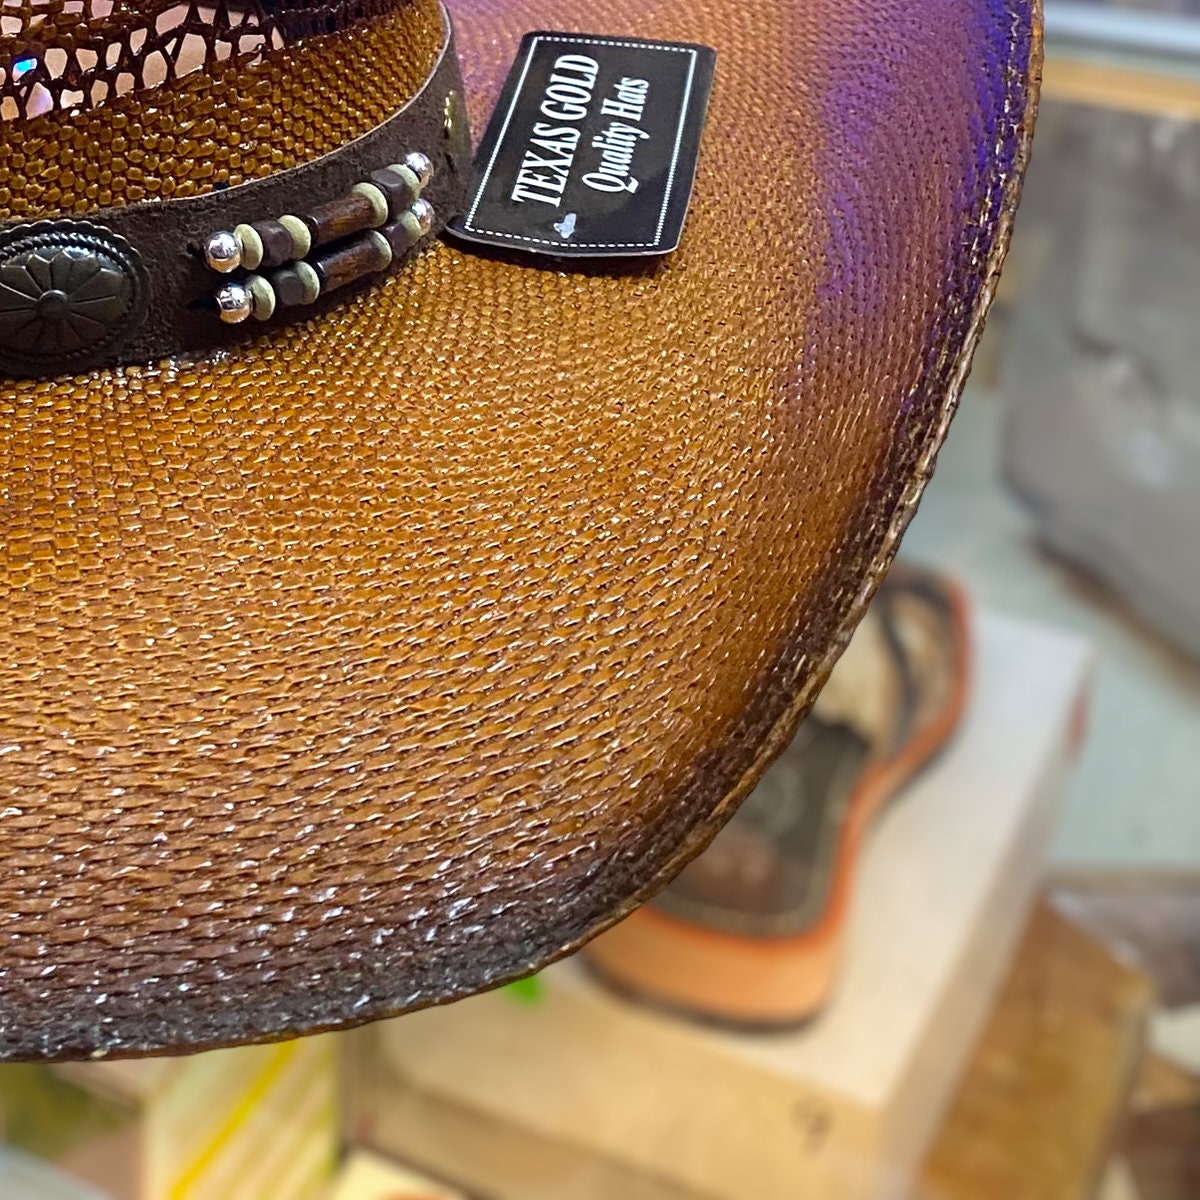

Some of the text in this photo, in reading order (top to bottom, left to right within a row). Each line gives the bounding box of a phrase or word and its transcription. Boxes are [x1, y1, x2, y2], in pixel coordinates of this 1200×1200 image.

[511, 54, 599, 208] TEXAS GOLD
[581, 77, 650, 193] Quality Hats
